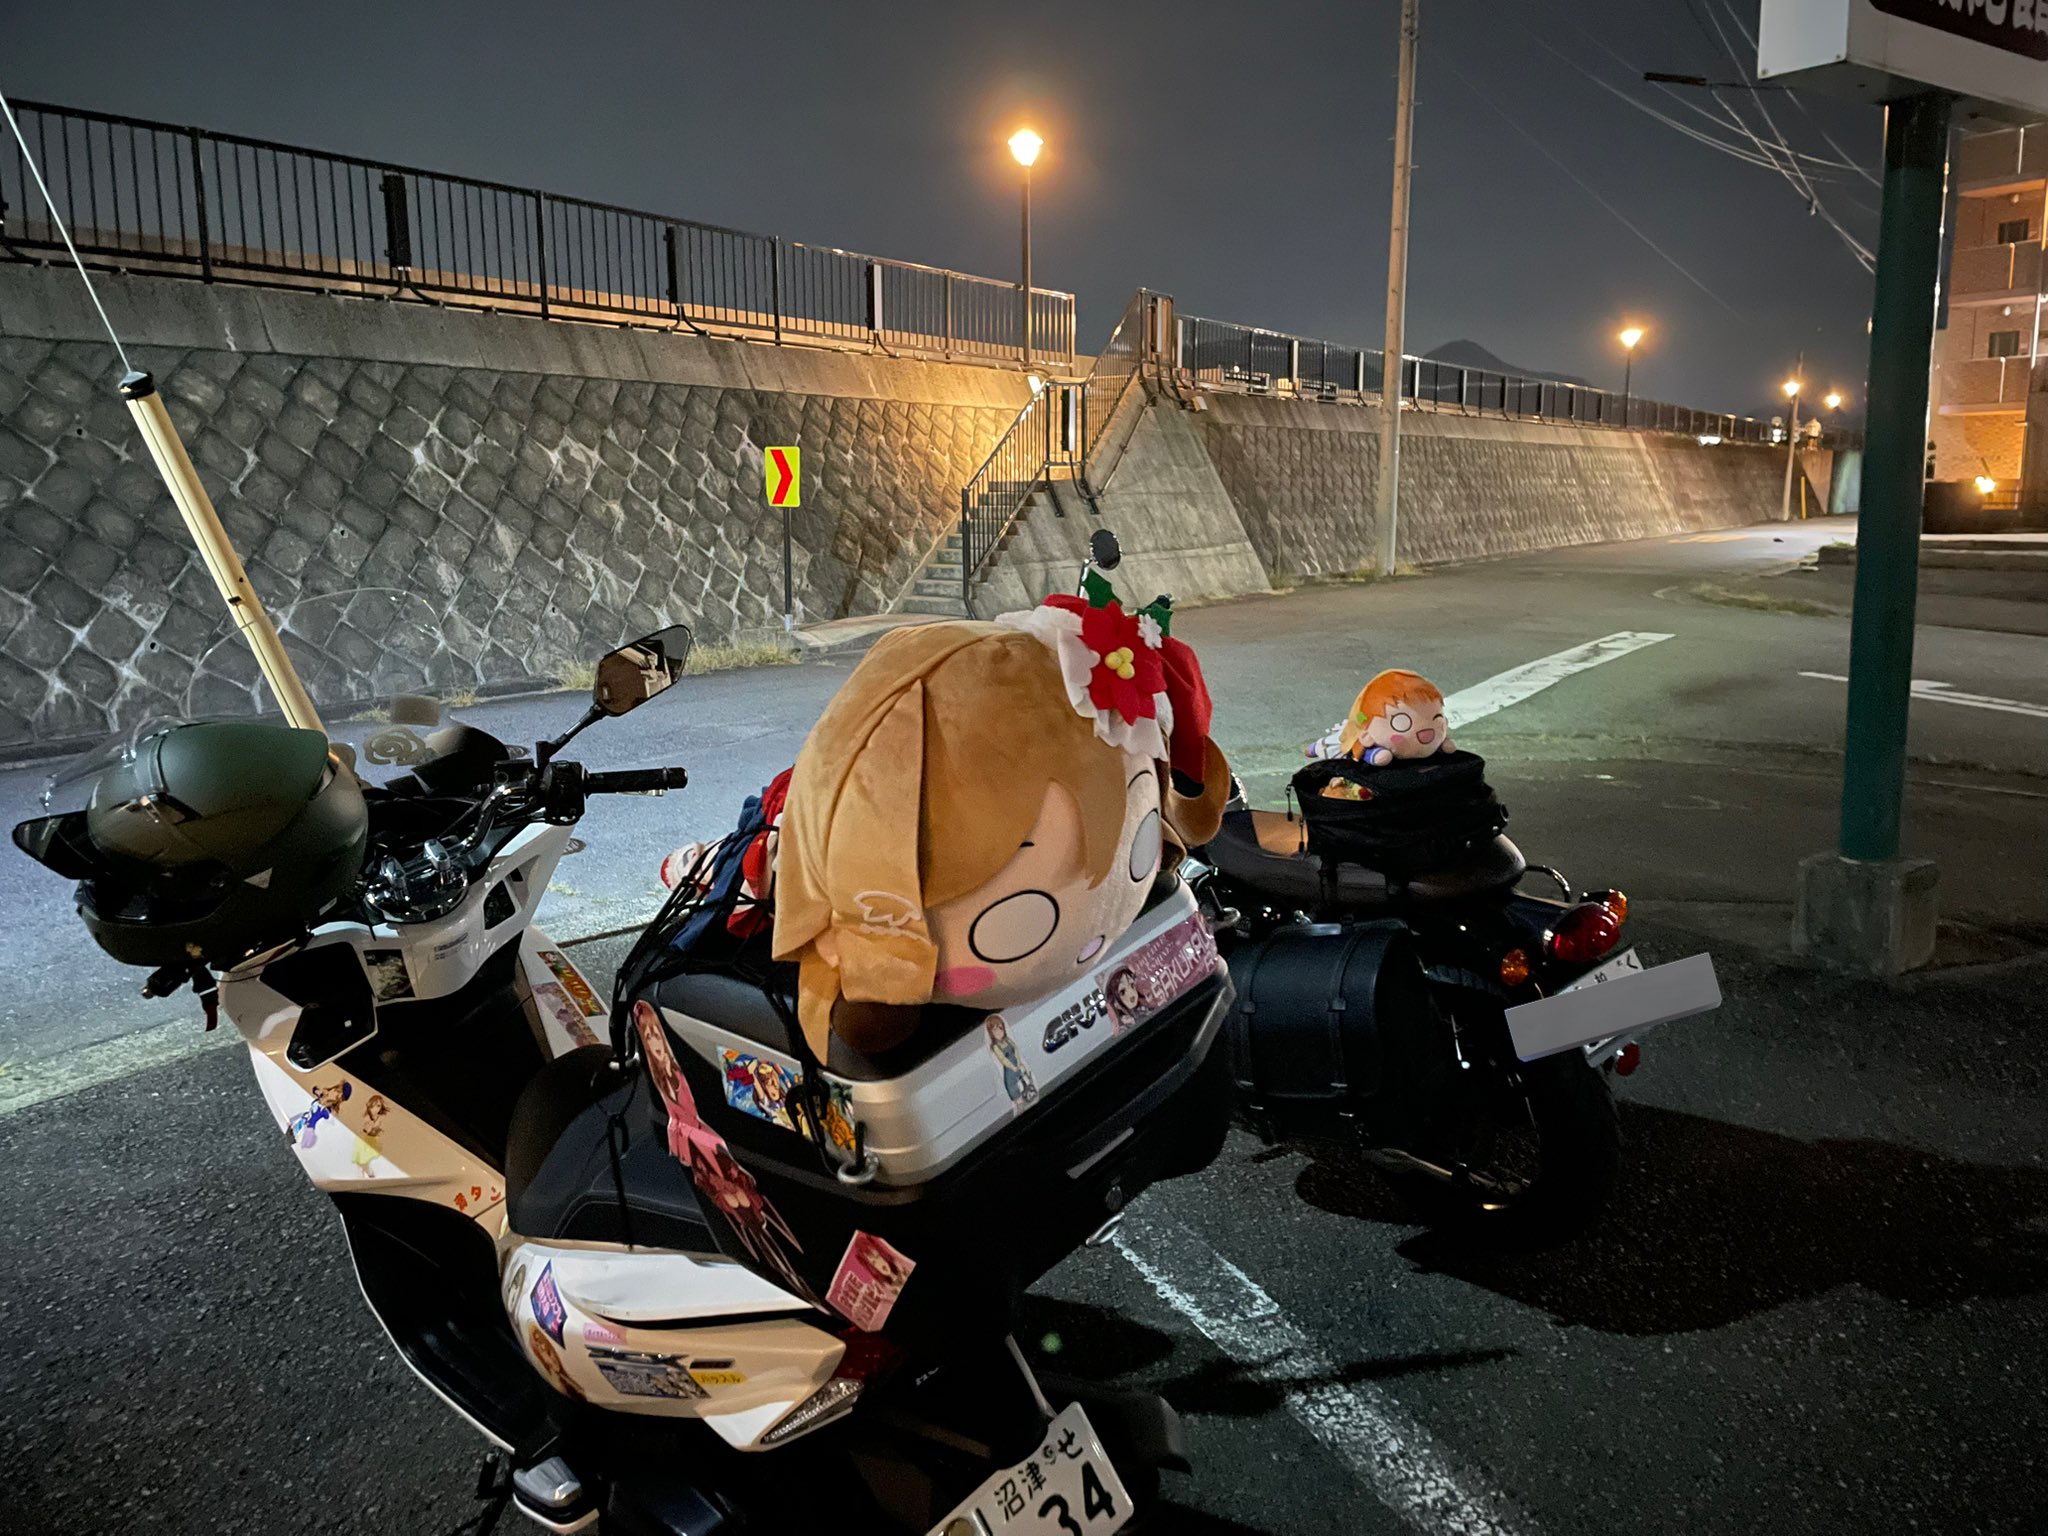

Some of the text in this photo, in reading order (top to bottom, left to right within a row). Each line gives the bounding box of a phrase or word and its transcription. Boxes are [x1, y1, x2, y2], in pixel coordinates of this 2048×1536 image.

[993, 1460, 1048, 1523] 沼津
[1057, 1427, 1084, 1460] せ
[1037, 1460, 1117, 1536] 34
